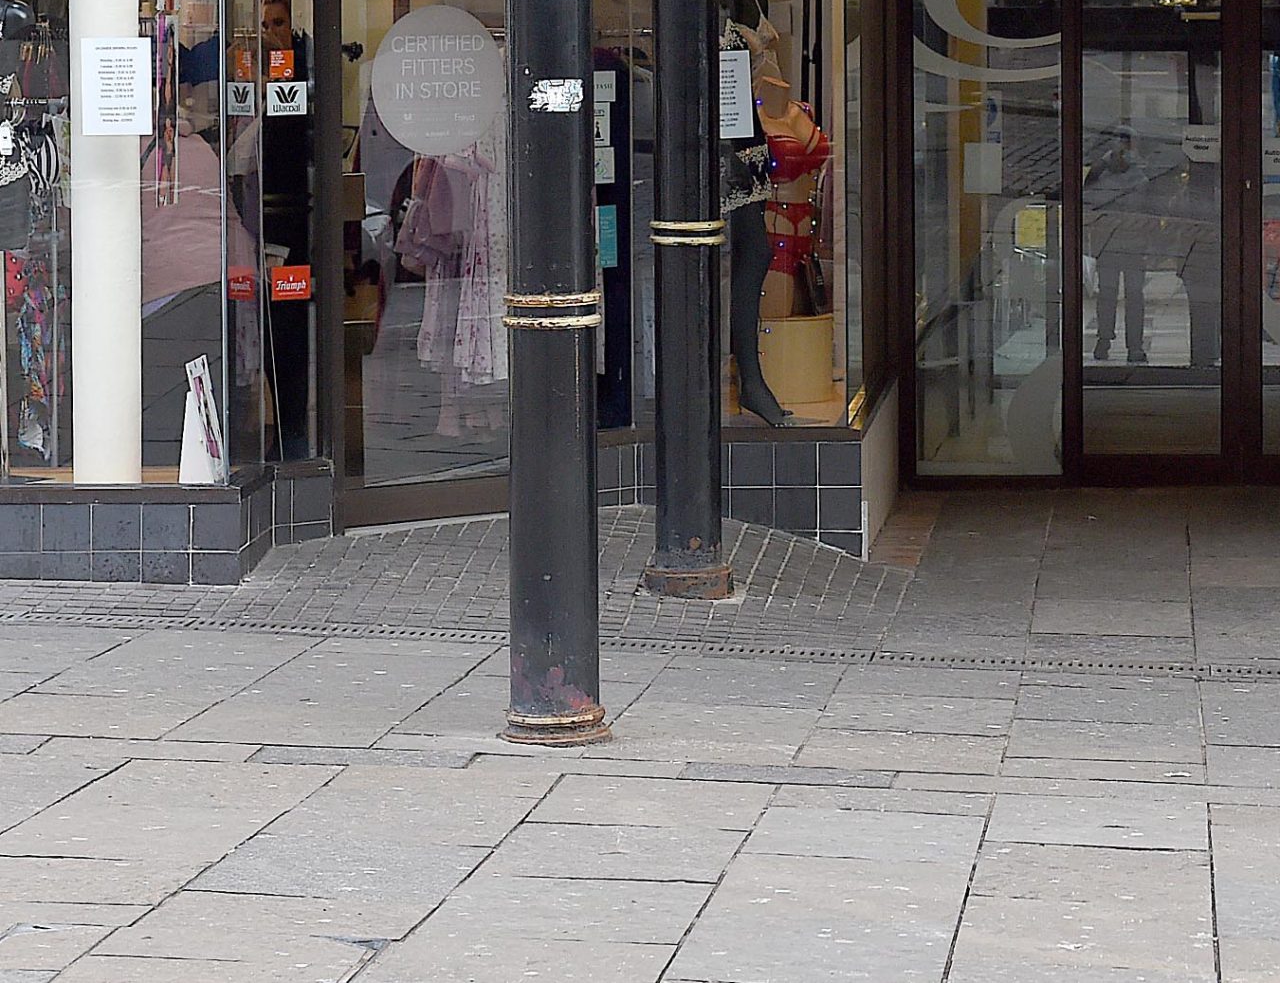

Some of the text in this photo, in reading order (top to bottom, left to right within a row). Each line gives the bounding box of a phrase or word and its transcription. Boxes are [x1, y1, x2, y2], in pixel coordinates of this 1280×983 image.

[391, 34, 485, 53] CERTIFIED
[401, 58, 476, 76] FITTERS
[395, 80, 482, 99] IN STORE
[276, 279, 307, 291] Triumph
